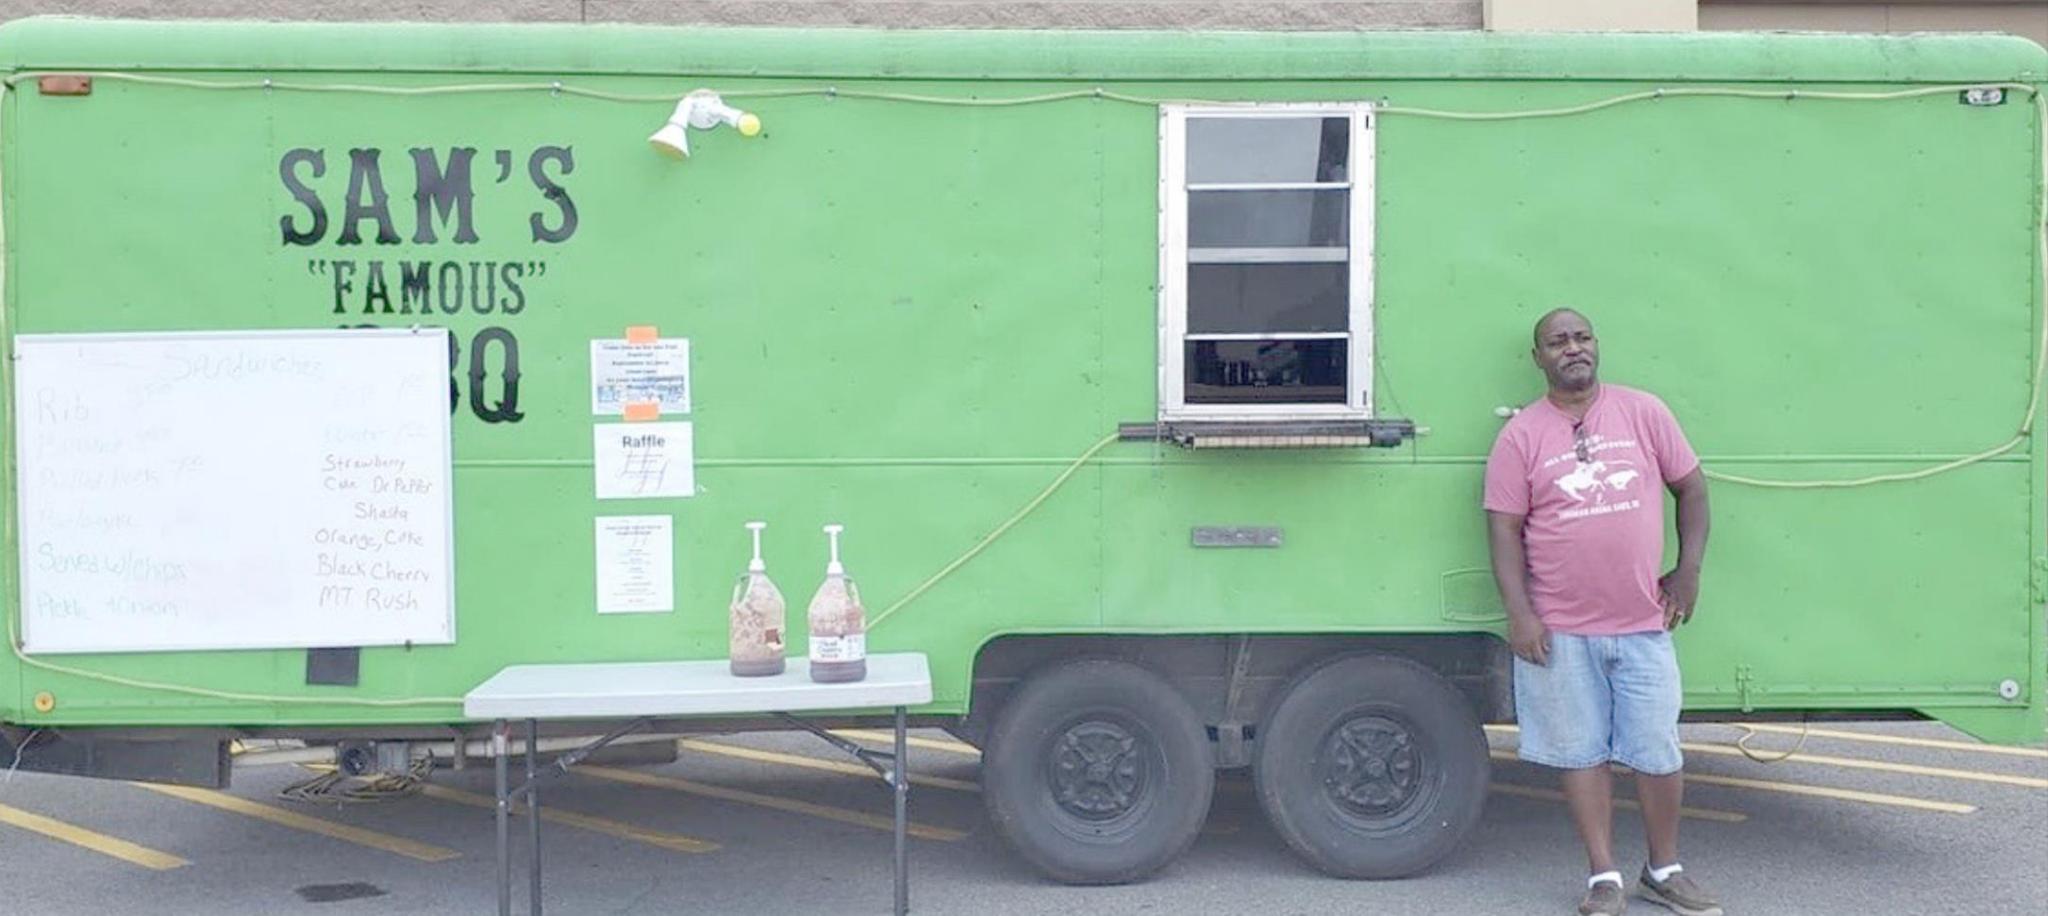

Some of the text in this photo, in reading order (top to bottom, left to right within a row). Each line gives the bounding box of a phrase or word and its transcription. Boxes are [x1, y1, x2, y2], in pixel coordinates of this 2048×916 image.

[279, 145, 579, 246] SAM'S
[37, 386, 90, 425] Rib
[622, 434, 666, 449] Raffle
[321, 453, 406, 473] Strawberry
[315, 553, 367, 577] Black
[319, 585, 419, 612] MT Rush
